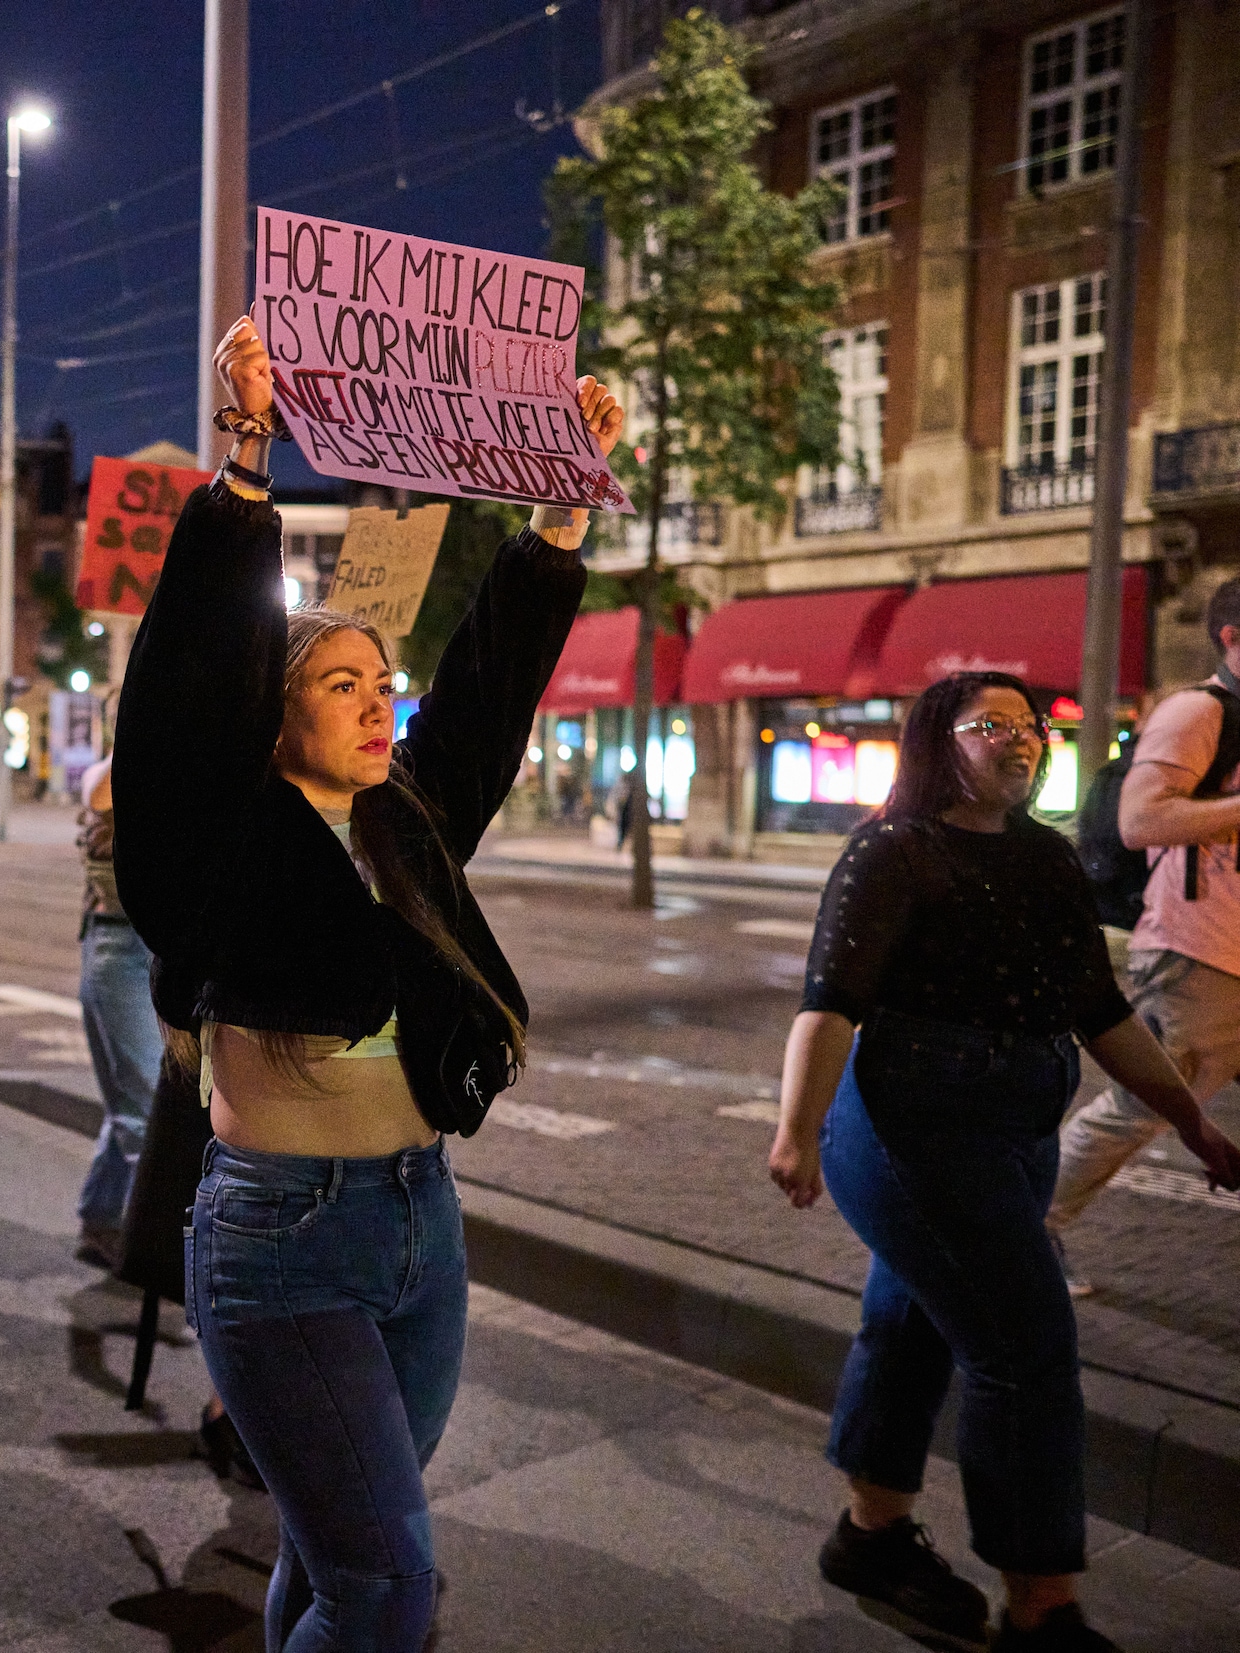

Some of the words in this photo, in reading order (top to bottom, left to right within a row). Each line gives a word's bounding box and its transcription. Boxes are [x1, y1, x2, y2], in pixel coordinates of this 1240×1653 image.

[264, 216, 340, 298] HOE
[350, 230, 392, 304] IK
[398, 241, 464, 321] MIJ
[469, 257, 582, 342] KLEED
[263, 294, 302, 364] IS
[313, 302, 410, 380] VOOR
[405, 318, 472, 390] MIJN
[475, 330, 577, 400] PLEZIER
[271, 366, 355, 425] NIET
[350, 377, 402, 432] OM
[394, 384, 445, 438] MIJ
[438, 389, 486, 444] TE
[480, 395, 596, 459] VOELEN
[304, 418, 380, 469] ALS
[363, 429, 448, 480] EEN
[431, 436, 603, 506] PROOIDIER
[109, 562, 161, 606] N
[330, 558, 386, 599] FAILED
